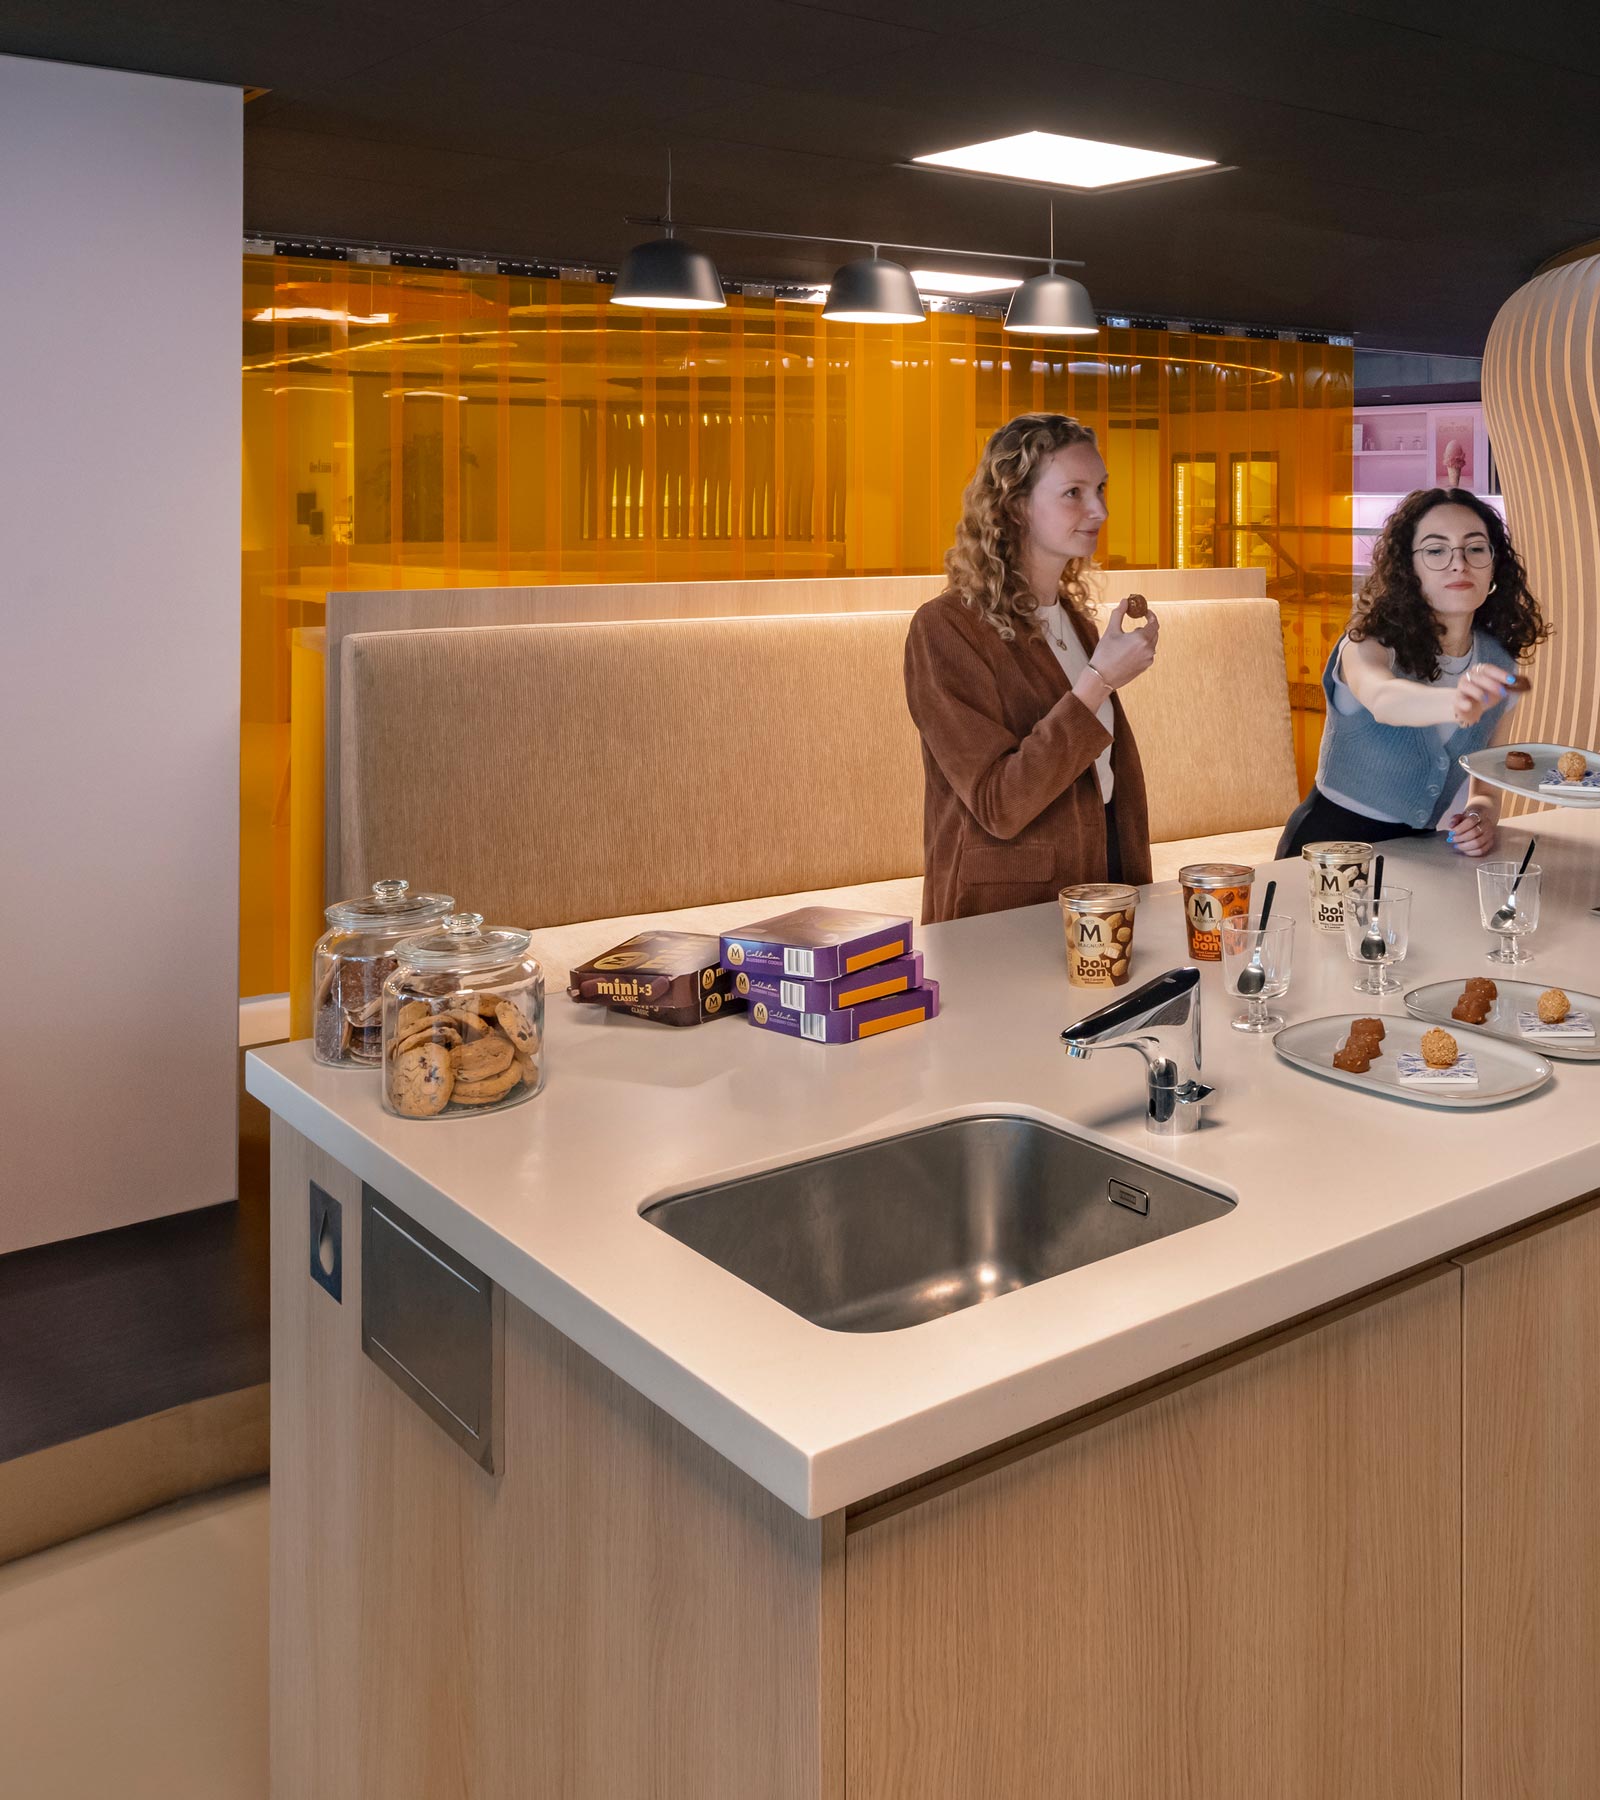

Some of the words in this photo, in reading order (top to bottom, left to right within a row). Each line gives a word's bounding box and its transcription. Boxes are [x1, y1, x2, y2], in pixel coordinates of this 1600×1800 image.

[1320, 875, 1340, 891] M
[1194, 900, 1213, 918] M
[1318, 911, 1344, 923] bon
[1079, 924, 1102, 942] M
[1192, 938, 1219, 951] bon
[597, 978, 638, 995] mini
[612, 995, 639, 1003] CLASSIC
